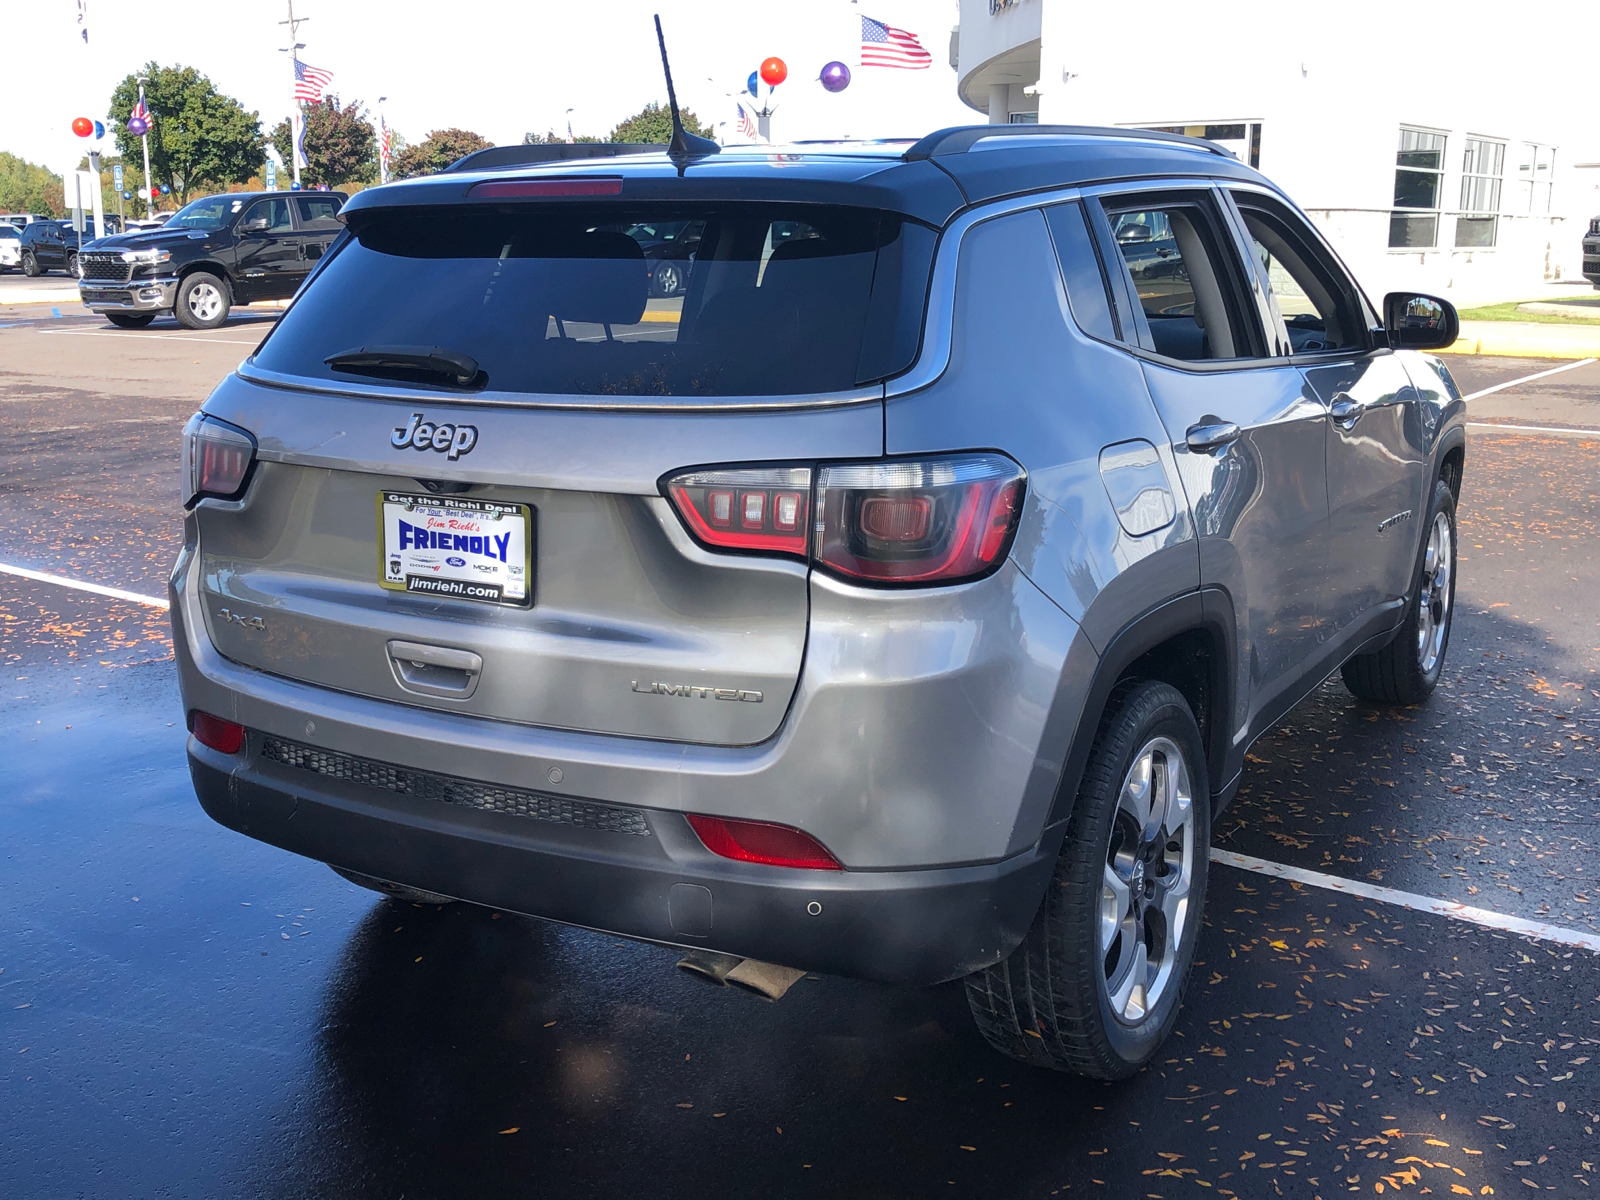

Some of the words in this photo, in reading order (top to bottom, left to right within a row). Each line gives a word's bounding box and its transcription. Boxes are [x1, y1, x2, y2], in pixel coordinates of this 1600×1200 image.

[391, 413, 478, 462] Jeep
[388, 494, 413, 503] Get
[417, 498, 440, 506] the
[444, 500, 480, 510] Riehl
[485, 504, 517, 514] Deal
[427, 508, 442, 517] Your
[426, 517, 445, 530] Jim
[448, 519, 480, 532] Riehl's
[398, 518, 511, 563] FRIENDLY
[473, 564, 498, 572] MOKE
[409, 577, 499, 598] jimriehl.com
[631, 680, 764, 703] LIMITED
